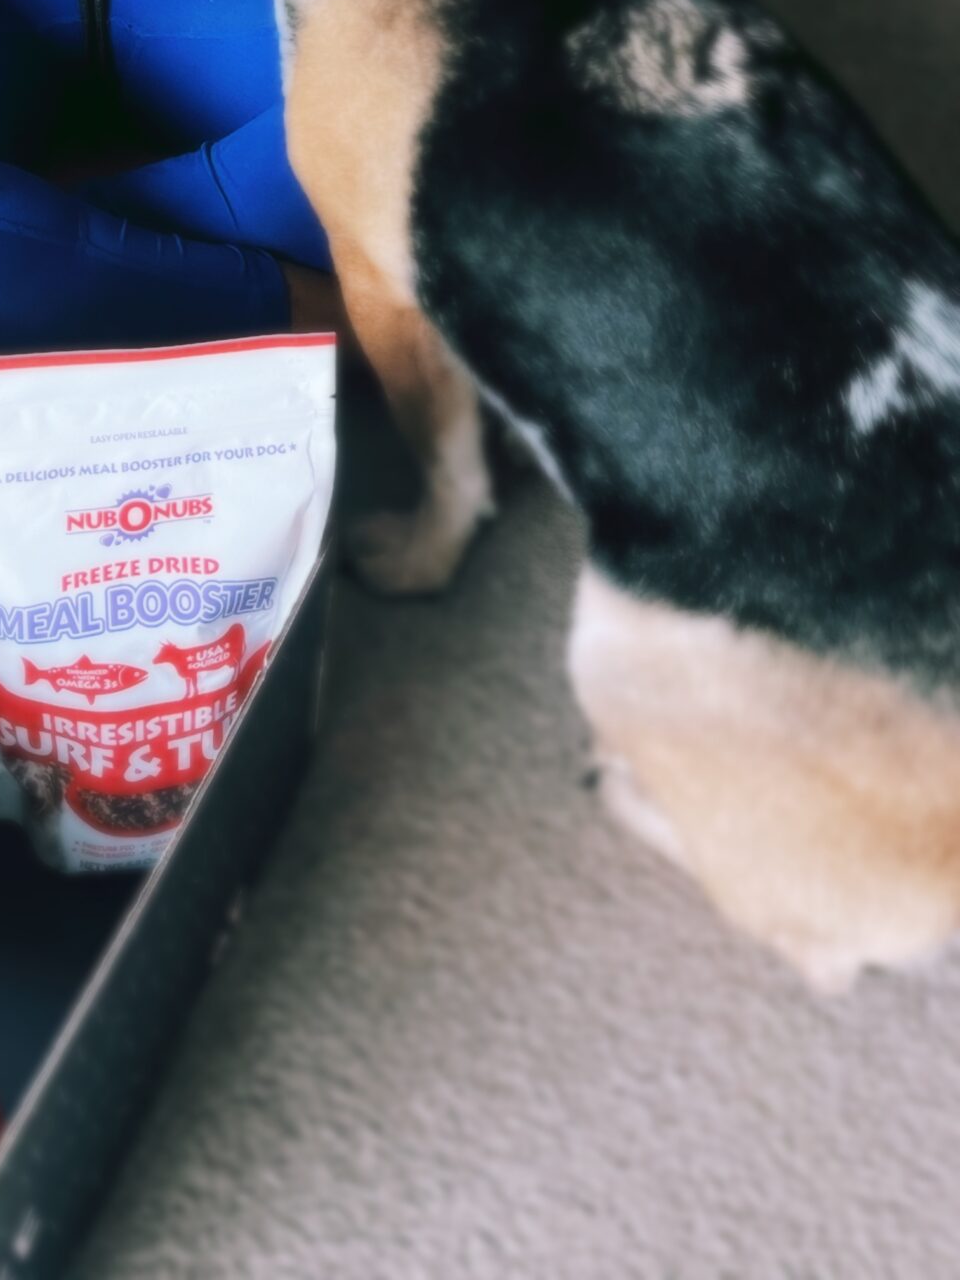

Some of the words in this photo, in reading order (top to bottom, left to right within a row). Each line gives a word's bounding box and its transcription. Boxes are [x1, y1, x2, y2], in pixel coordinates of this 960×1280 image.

[90, 435, 112, 444] EASY
[112, 432, 137, 442] OPEN
[5, 466, 76, 483] DELICIOUS
[79, 462, 118, 476] MEAL
[121, 456, 183, 472] BOOSTER
[185, 451, 211, 465] FOR
[214, 447, 254, 461] YOUR
[257, 443, 287, 456] DOG
[61, 559, 141, 593] FREEZE
[148, 556, 220, 575] DRIED
[104, 576, 279, 634] BOOSTER
[196, 644, 224, 661] USA
[55, 678, 102, 689] OMEGA
[43, 690, 238, 746] IRRESISTIBLE
[123, 744, 163, 782] &
